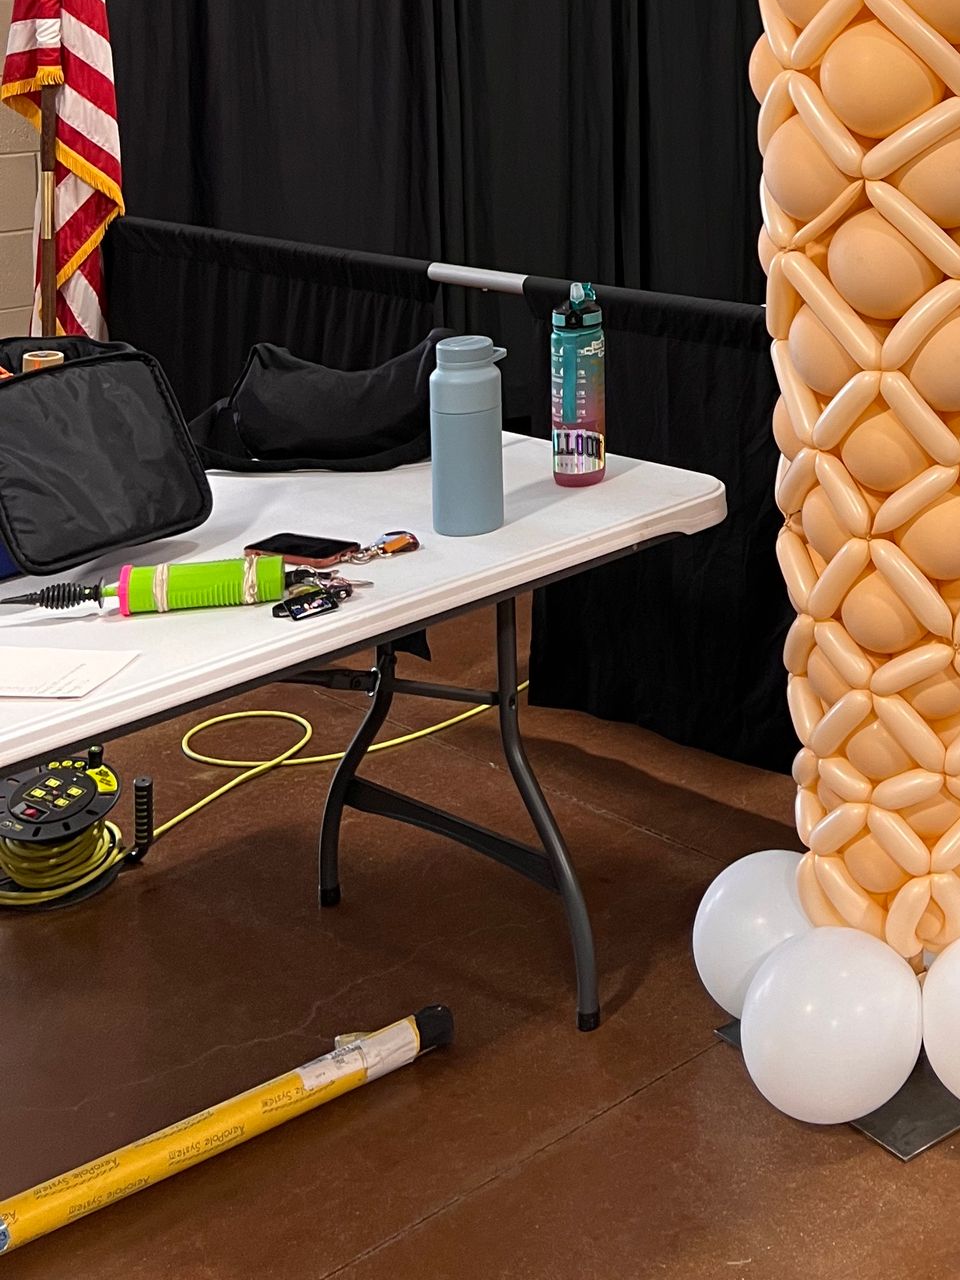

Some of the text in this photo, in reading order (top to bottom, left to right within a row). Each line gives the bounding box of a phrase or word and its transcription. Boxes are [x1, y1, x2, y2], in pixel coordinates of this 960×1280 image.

[168, 1124, 246, 1161] AeroPole System
[33, 1157, 118, 1197] AeroPole System
[68, 1194, 103, 1215] System
